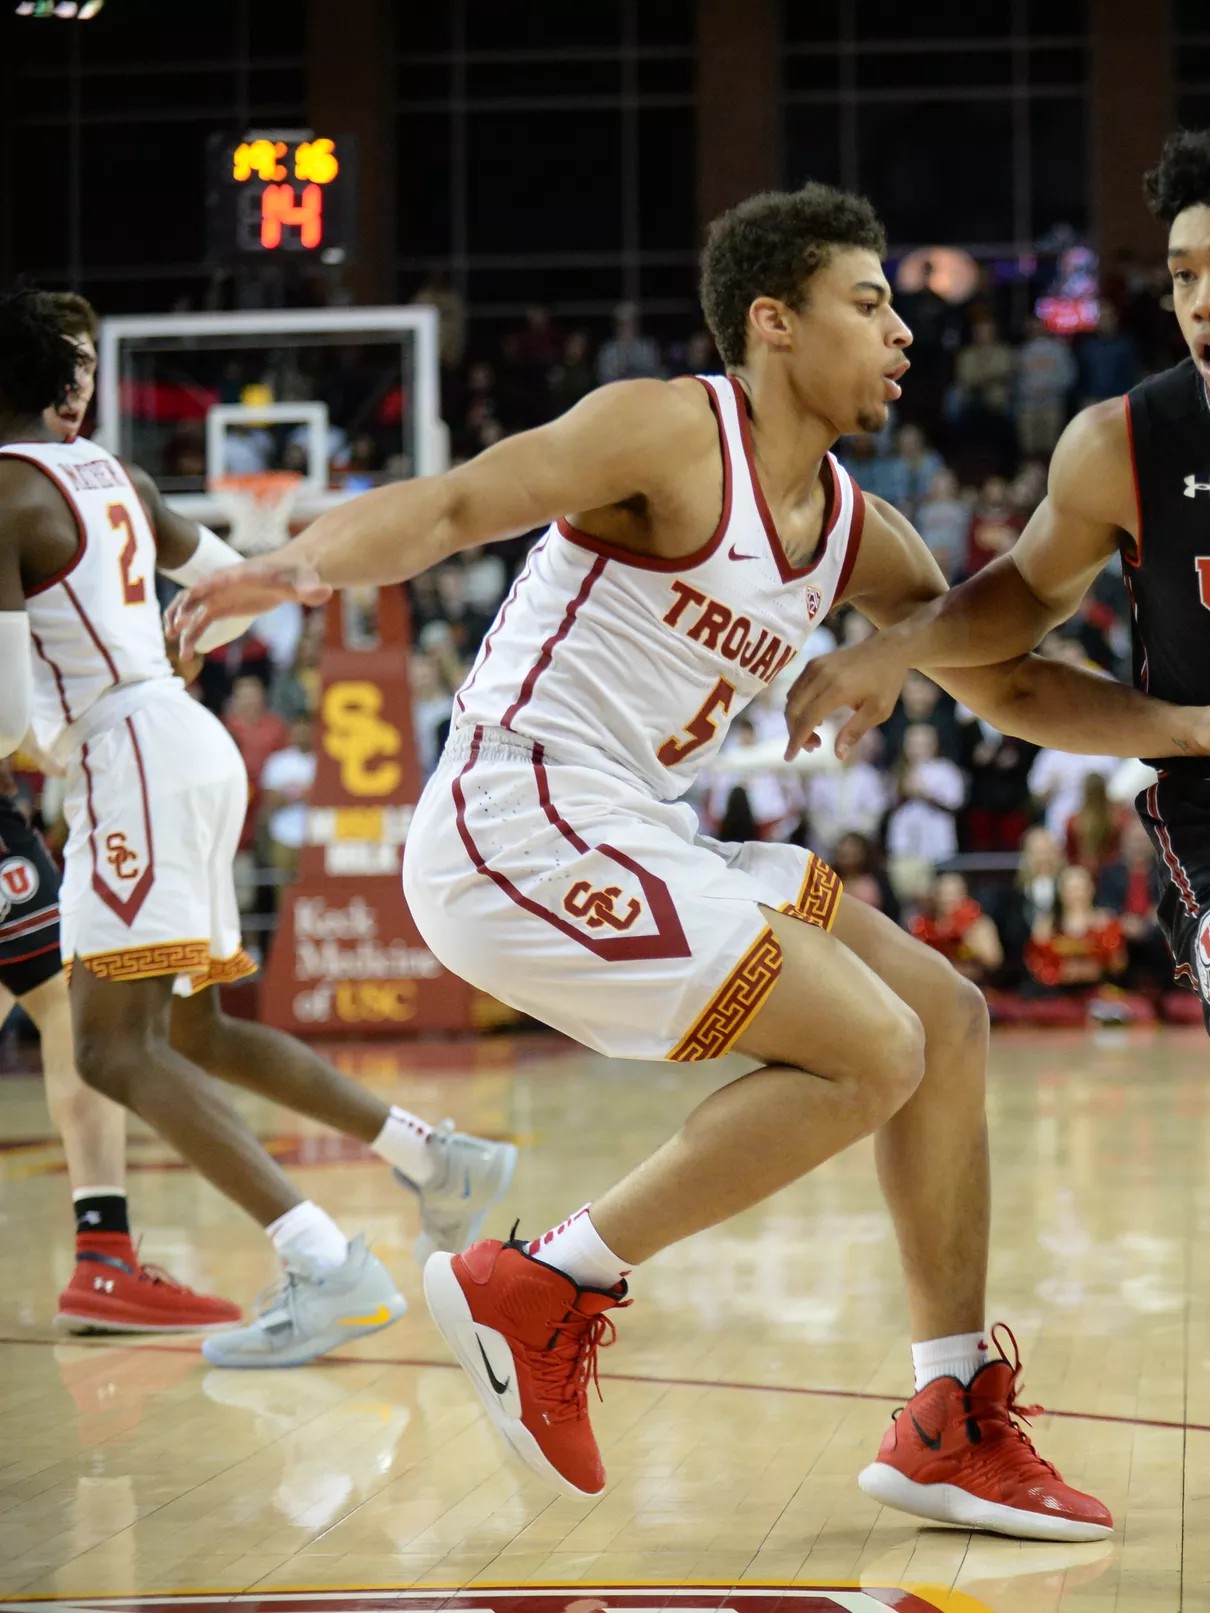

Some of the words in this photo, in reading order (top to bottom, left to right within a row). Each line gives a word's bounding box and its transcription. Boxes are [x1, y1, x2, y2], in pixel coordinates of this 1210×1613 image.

[261, 184, 322, 249] 14
[106, 501, 147, 607] 2
[655, 673, 737, 769] 5
[105, 831, 139, 880] SC
[562, 878, 642, 932] SC
